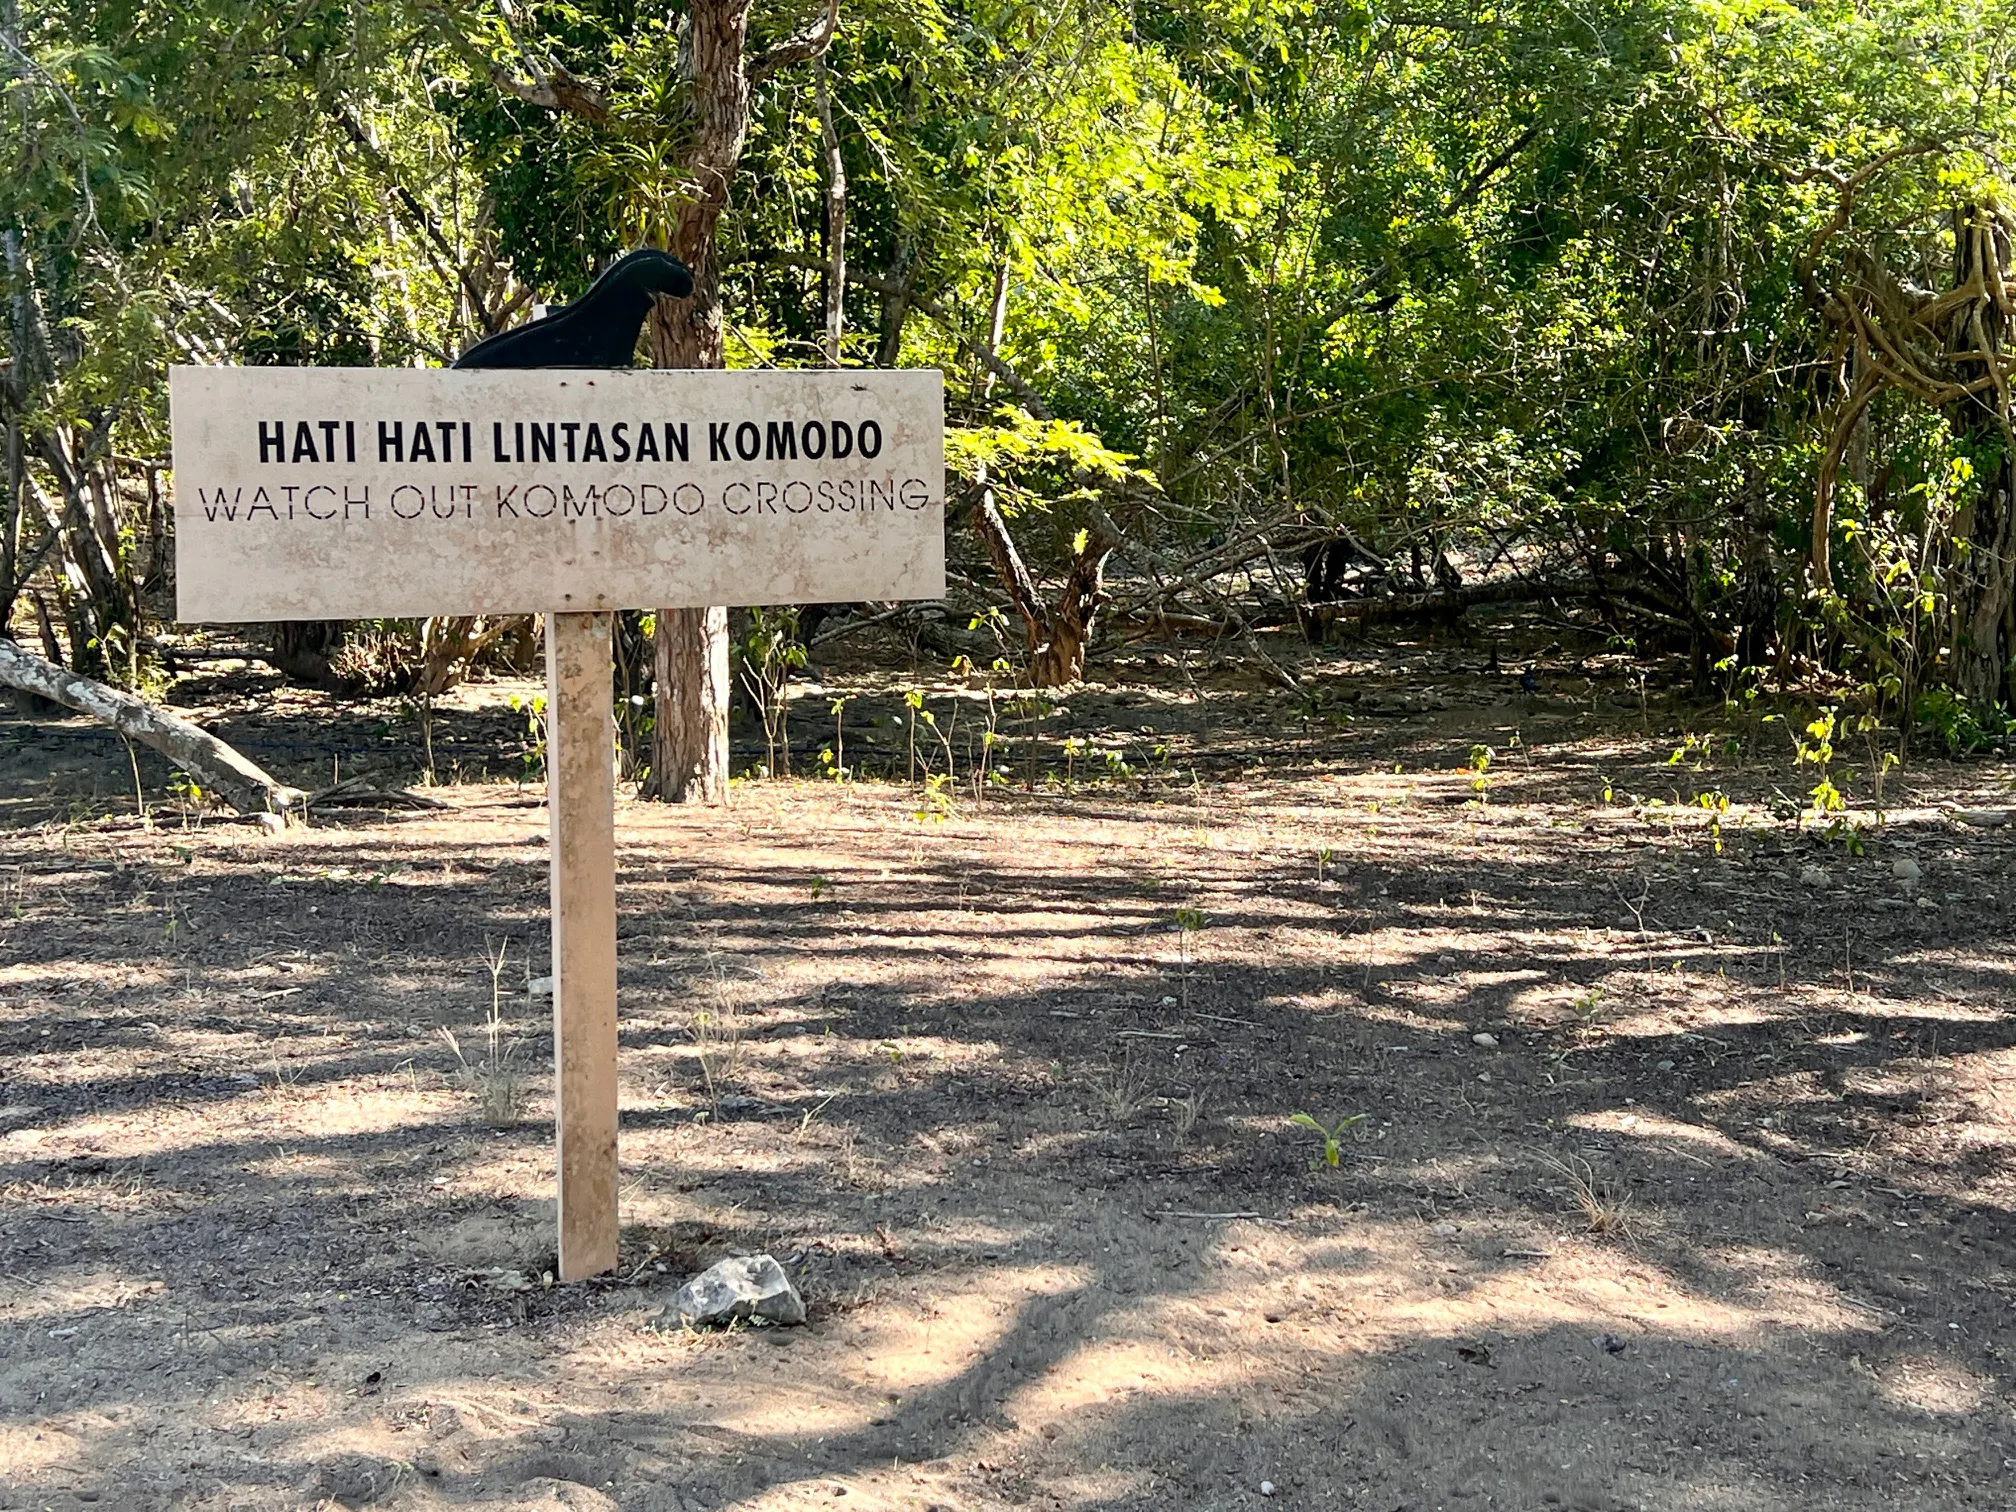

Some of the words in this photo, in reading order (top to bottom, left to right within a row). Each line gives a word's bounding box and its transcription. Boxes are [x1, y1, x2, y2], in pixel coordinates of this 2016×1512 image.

[258, 420, 356, 463] HATI
[377, 420, 472, 463] HATI
[493, 421, 690, 463] LINTASAN
[709, 420, 883, 462] KOMODO
[198, 484, 370, 522] WATCH
[390, 484, 478, 519] OUT
[496, 483, 705, 519] KOMODO
[722, 478, 930, 515] CROSSING
